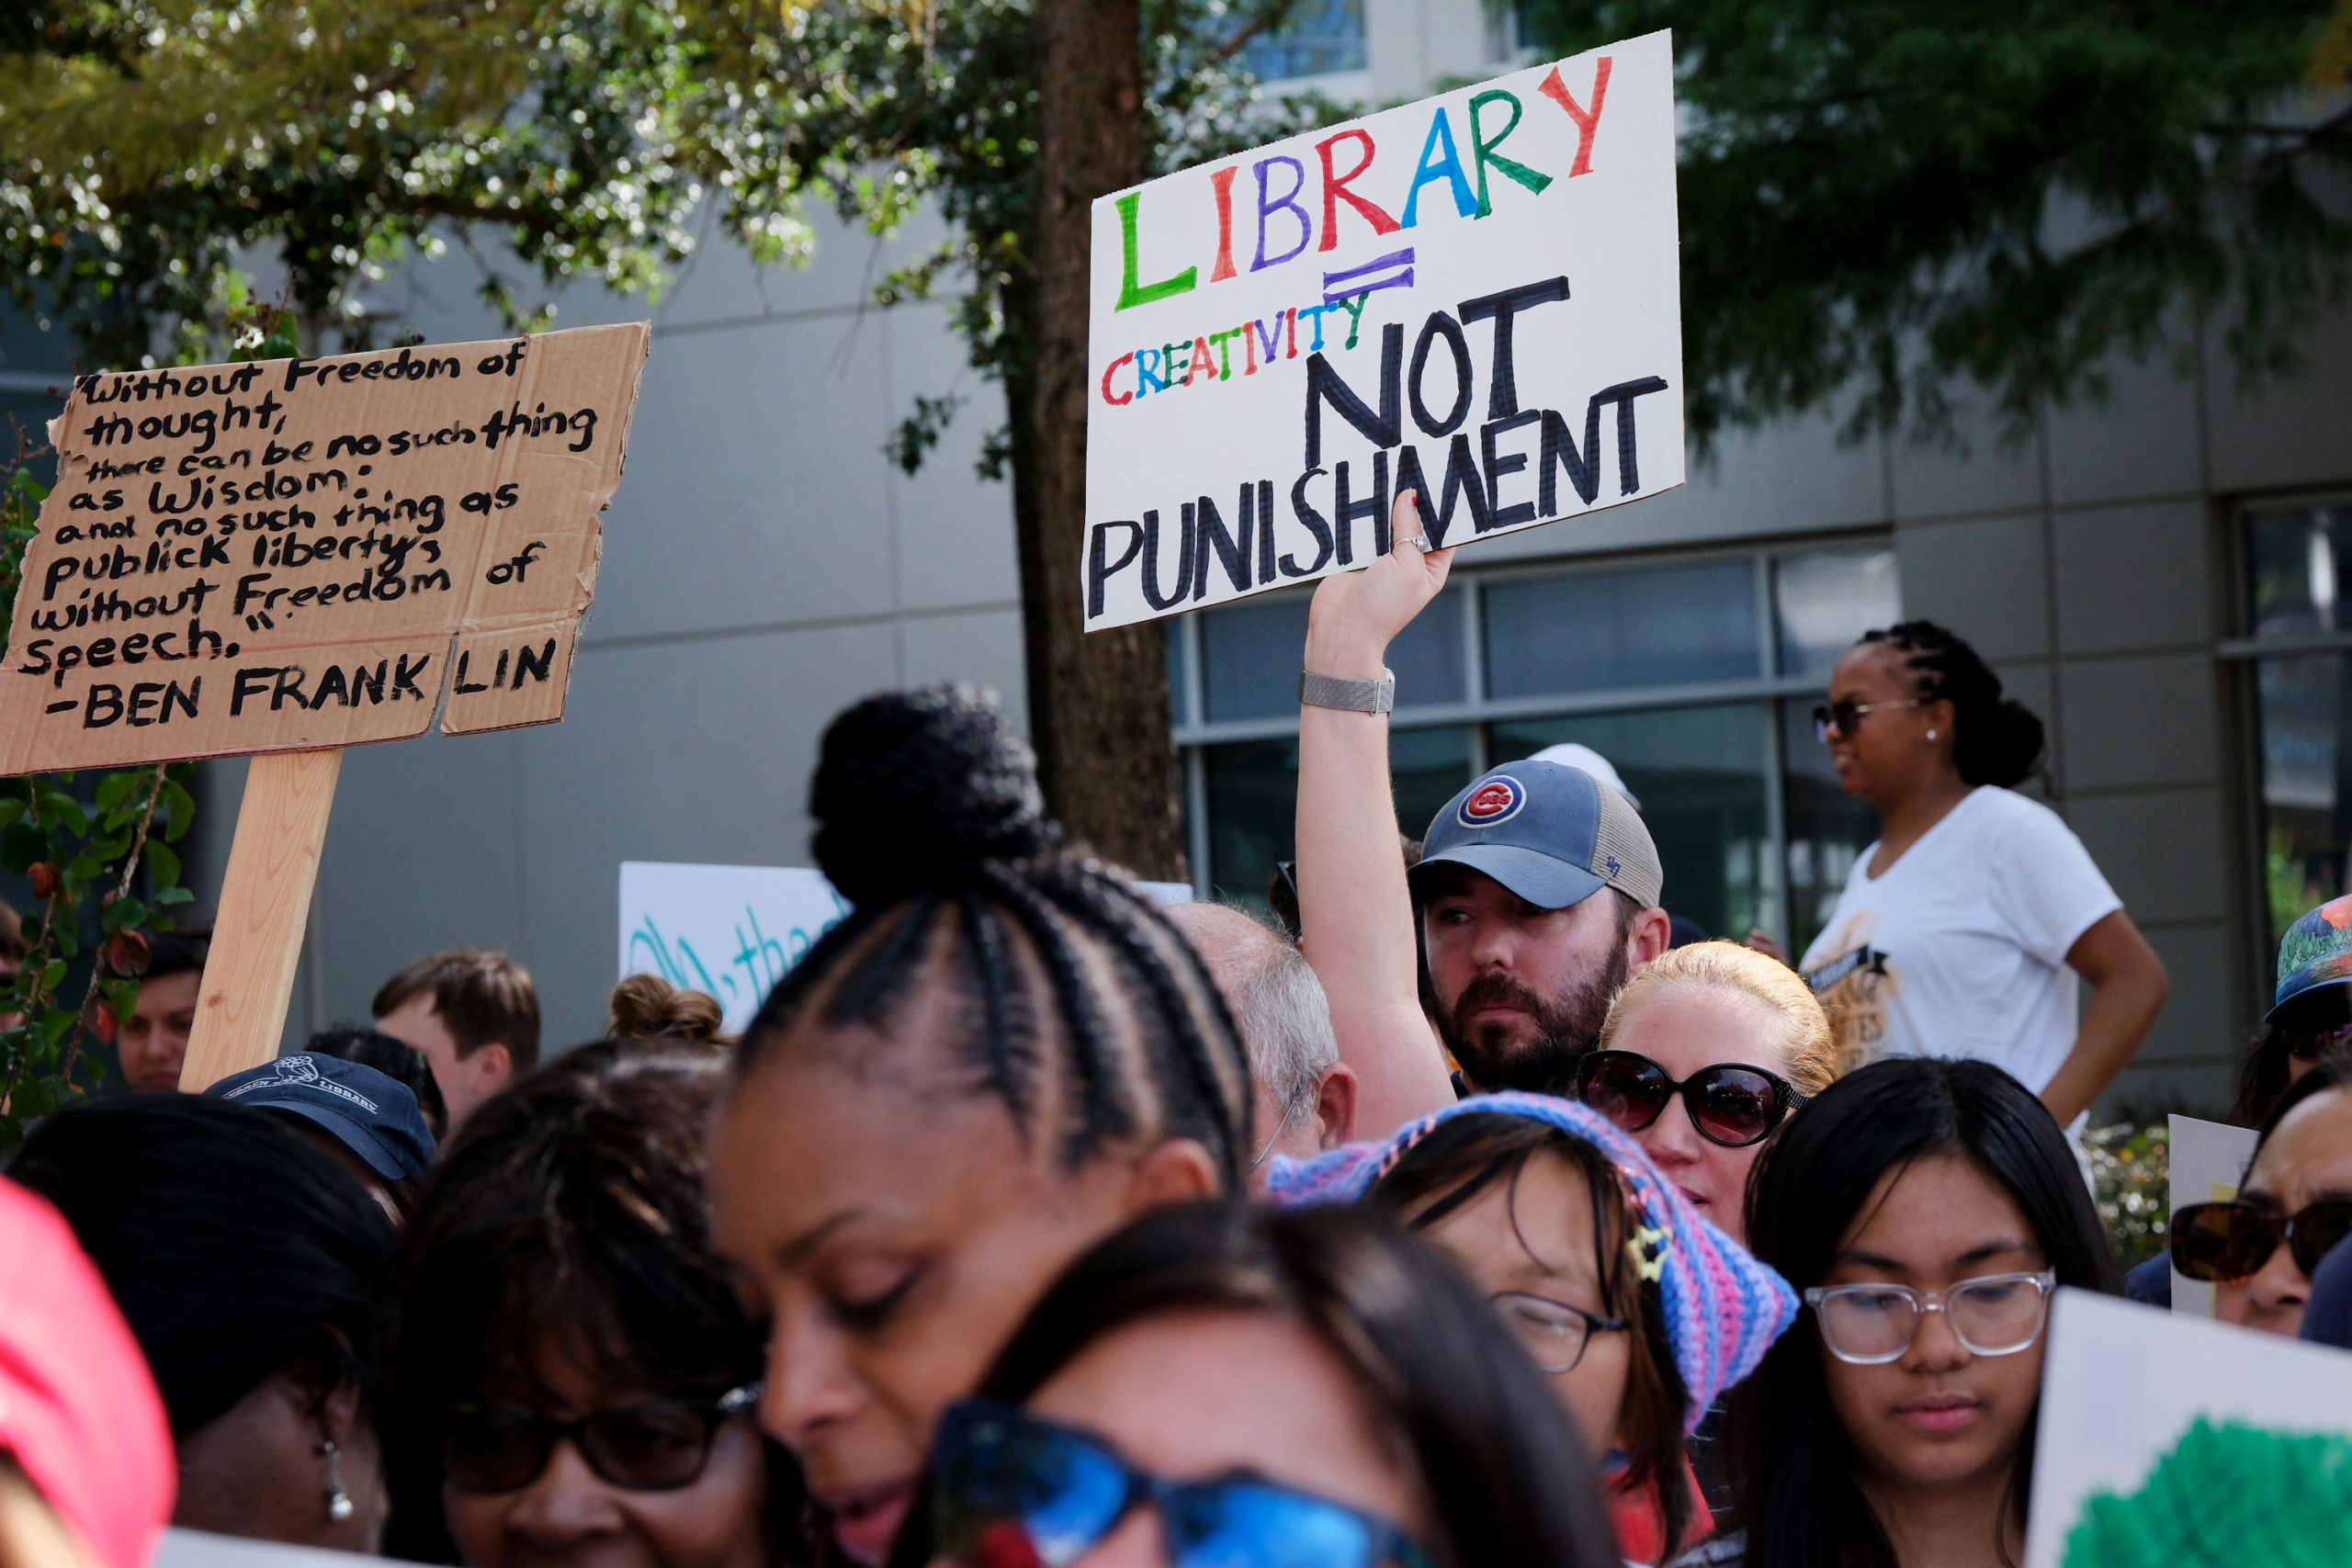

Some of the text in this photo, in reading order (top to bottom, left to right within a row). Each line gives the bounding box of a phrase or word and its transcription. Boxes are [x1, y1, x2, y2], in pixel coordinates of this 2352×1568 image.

[1114, 56, 1612, 313] LIBRARY
[284, 348, 460, 391] Freedom
[477, 342, 526, 377] of
[1102, 291, 1370, 406] CREATIVITY
[1305, 276, 1570, 471] NOT
[85, 390, 287, 454] thought,
[178, 449, 251, 476] can
[262, 440, 313, 466] be
[481, 400, 598, 453] thing
[55, 515, 137, 545] and
[334, 490, 446, 534] thing
[459, 483, 519, 516] as
[68, 489, 124, 512] as
[1088, 376, 1668, 619] PUNISHMENT
[31, 542, 547, 632] without Freedom of
[318, 1080, 378, 1111] LIBRARY
